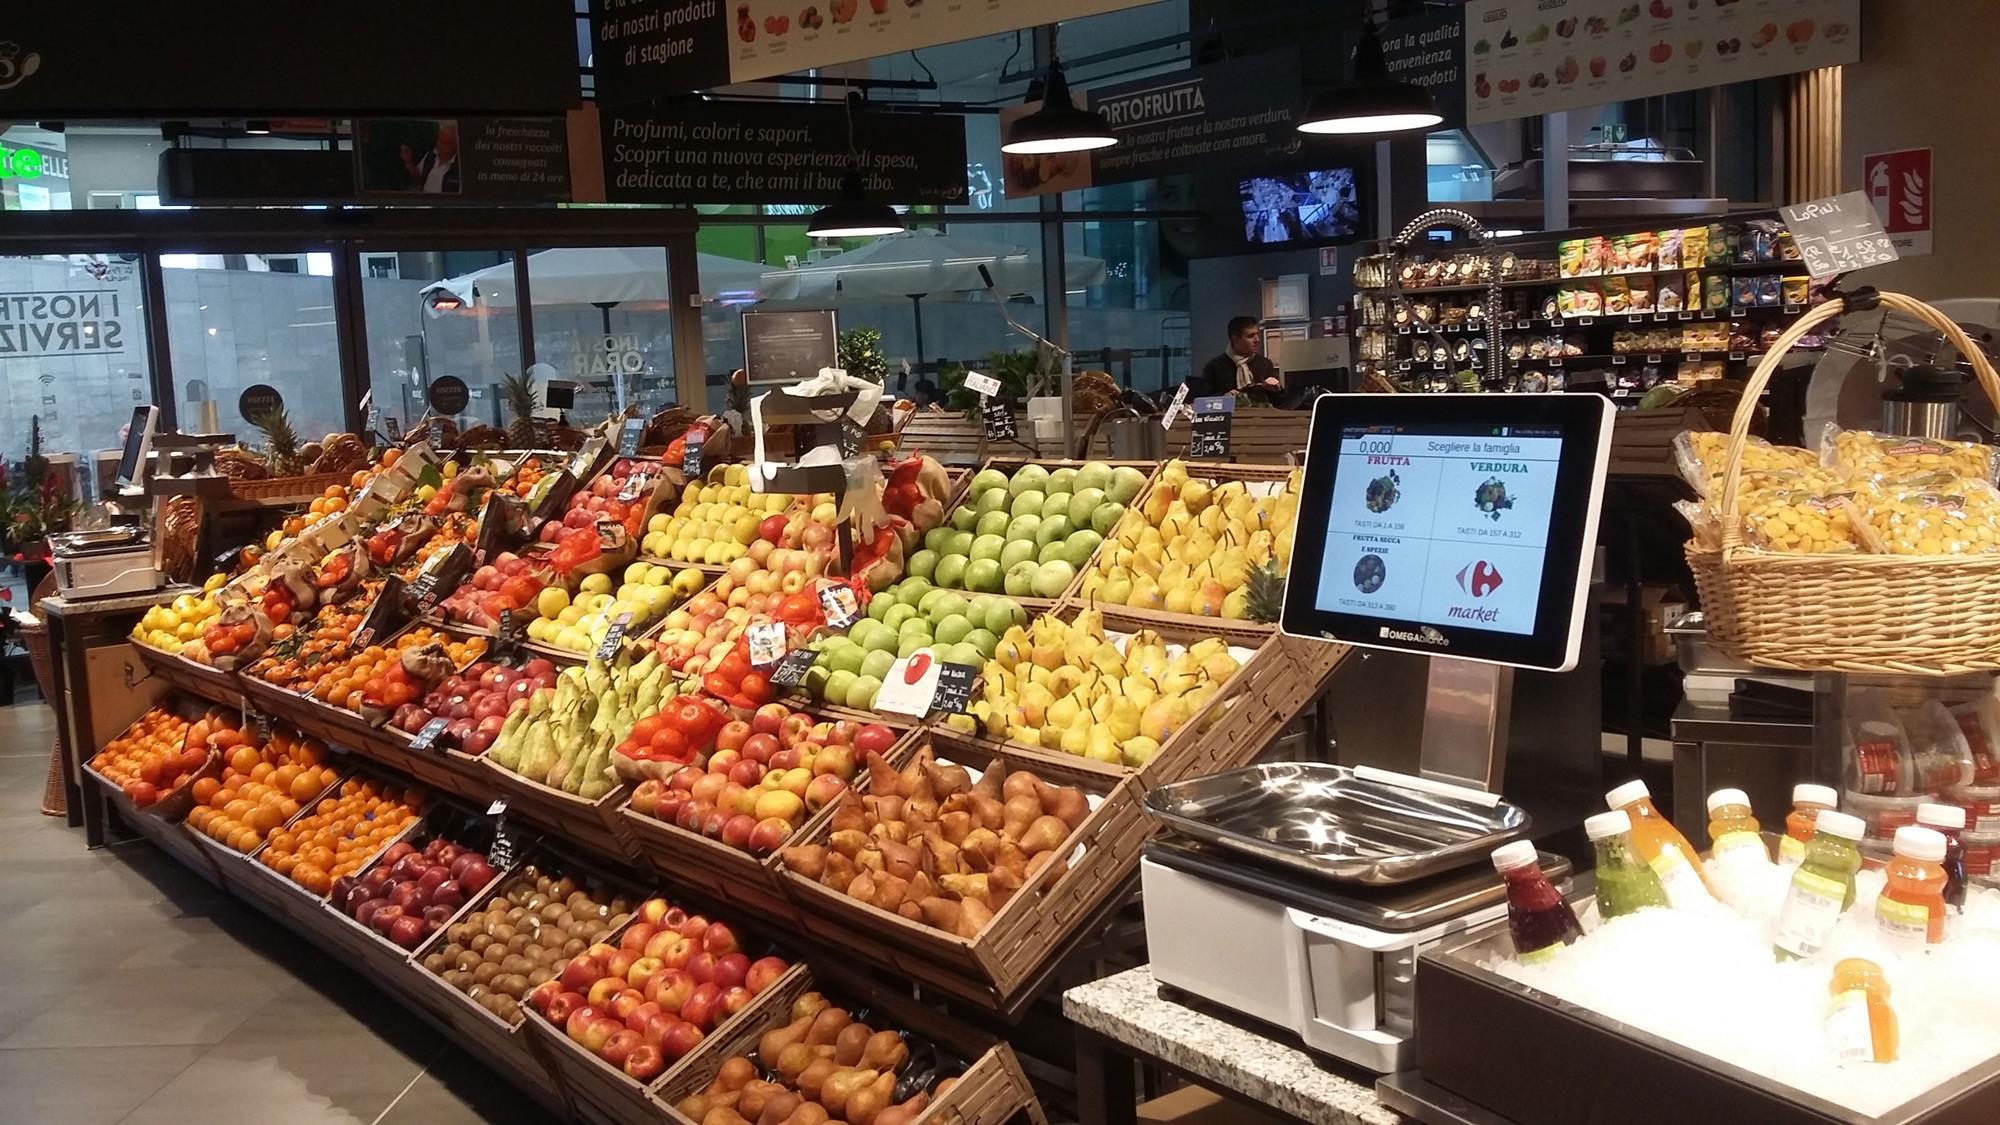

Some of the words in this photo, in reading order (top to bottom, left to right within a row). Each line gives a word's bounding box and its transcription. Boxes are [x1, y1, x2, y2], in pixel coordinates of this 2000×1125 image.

[601, 19, 618, 42] dei
[623, 9, 659, 36] nostri
[663, 0, 717, 32] prodotti
[1404, 33, 1415, 48] la
[1418, 22, 1461, 47] qualità
[625, 45, 637, 66] di
[640, 37, 694, 65] stagione
[1385, 48, 1452, 73] onvenienza
[497, 126, 550, 138] freschezza
[1137, 130, 1165, 144] nostra
[1167, 124, 1194, 144] frutta
[1196, 124, 1202, 135] e
[1204, 119, 1213, 133] la
[1214, 116, 1246, 132] nostra
[1248, 106, 1292, 126] verdura,
[612, 118, 688, 143] Profumi,
[691, 120, 740, 141] colori
[744, 126, 754, 140] e
[757, 125, 812, 147] sapori.
[474, 140, 490, 151] dei
[492, 141, 523, 152] nostri
[525, 142, 563, 154] raccolti
[1132, 148, 1163, 168] fresche
[1165, 149, 1170, 159] e
[1171, 140, 1211, 161] coltivate
[1213, 138, 1231, 151] con
[1232, 131, 1268, 148] amore.
[492, 157, 548, 169] consegnati
[614, 144, 671, 167] Scopri
[675, 150, 707, 165] una
[712, 151, 763, 166] nuova
[767, 149, 850, 171] esperienza
[856, 150, 871, 168] di
[874, 152, 919, 173] spesa,
[477, 172, 488, 182] in
[490, 173, 518, 183] meno
[520, 172, 530, 183] di
[532, 172, 546, 183] 24
[547, 174, 564, 183] ore
[616, 168, 691, 190] dedicata
[697, 174, 709, 189] a
[714, 172, 732, 192] te,
[735, 172, 763, 190] che
[767, 173, 799, 190] ami
[803, 173, 813, 191] il
[1427, 441, 1470, 454] Scegliere
[1472, 441, 1481, 453] la
[1483, 442, 1521, 455] famiglia
[1367, 456, 1410, 466] FRUTTA
[1470, 462, 1529, 474] VERDURA
[1355, 519, 1372, 529] TASTI
[1374, 521, 1383, 529] DA
[1388, 522, 1393, 530] A
[1353, 534, 1378, 544] FRUTTA
[1379, 536, 1401, 544] SECCA
[1457, 527, 1475, 536] TASTI
[1477, 528, 1488, 537] DA
[1503, 530, 1508, 538] A
[1509, 530, 1522, 539] 312
[1367, 546, 1389, 554] SPEZIE
[1338, 598, 1356, 608] TASTI
[1357, 600, 1367, 608] DA
[1379, 602, 1385, 610] A
[1448, 604, 1499, 622] market
